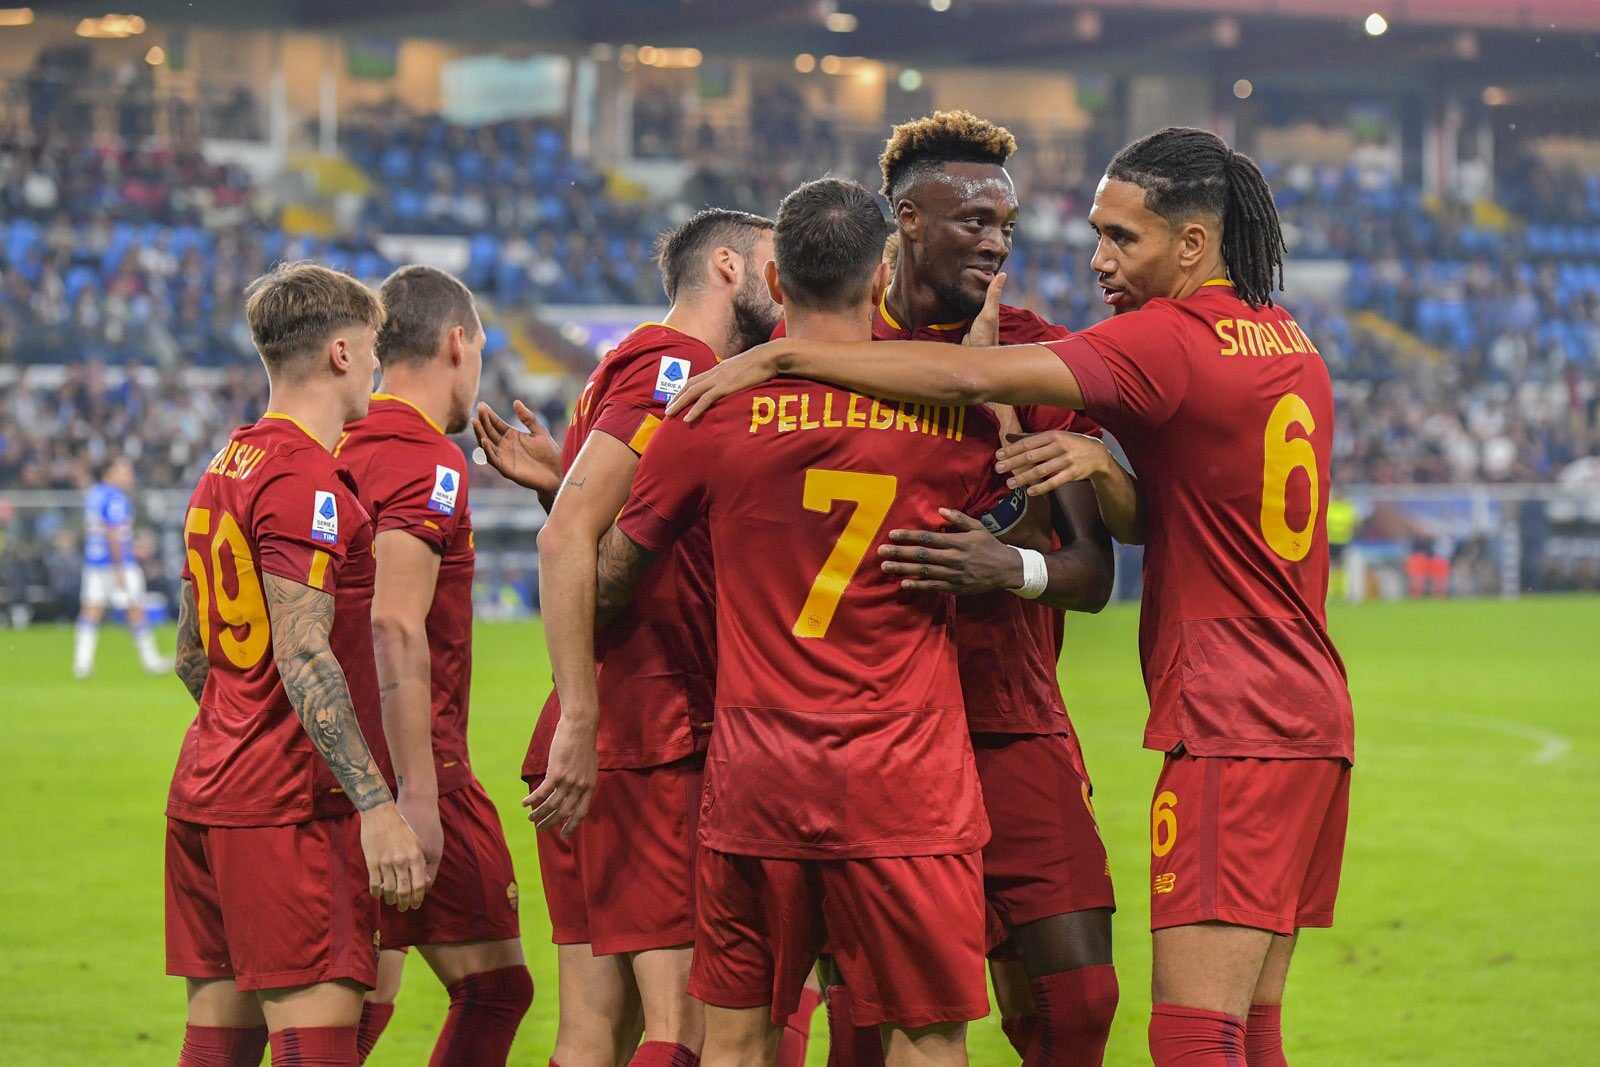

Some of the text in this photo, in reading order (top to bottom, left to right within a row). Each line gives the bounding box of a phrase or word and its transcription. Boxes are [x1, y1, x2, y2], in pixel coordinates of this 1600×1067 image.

[660, 381, 677, 389] SERIE
[748, 392, 966, 442] PELLEGRINI
[1260, 392, 1319, 562] 6
[322, 532, 335, 542] TIM
[439, 503, 452, 514] TIM
[792, 468, 898, 639] 7
[183, 507, 271, 669] 59
[1152, 790, 1178, 858] 6
